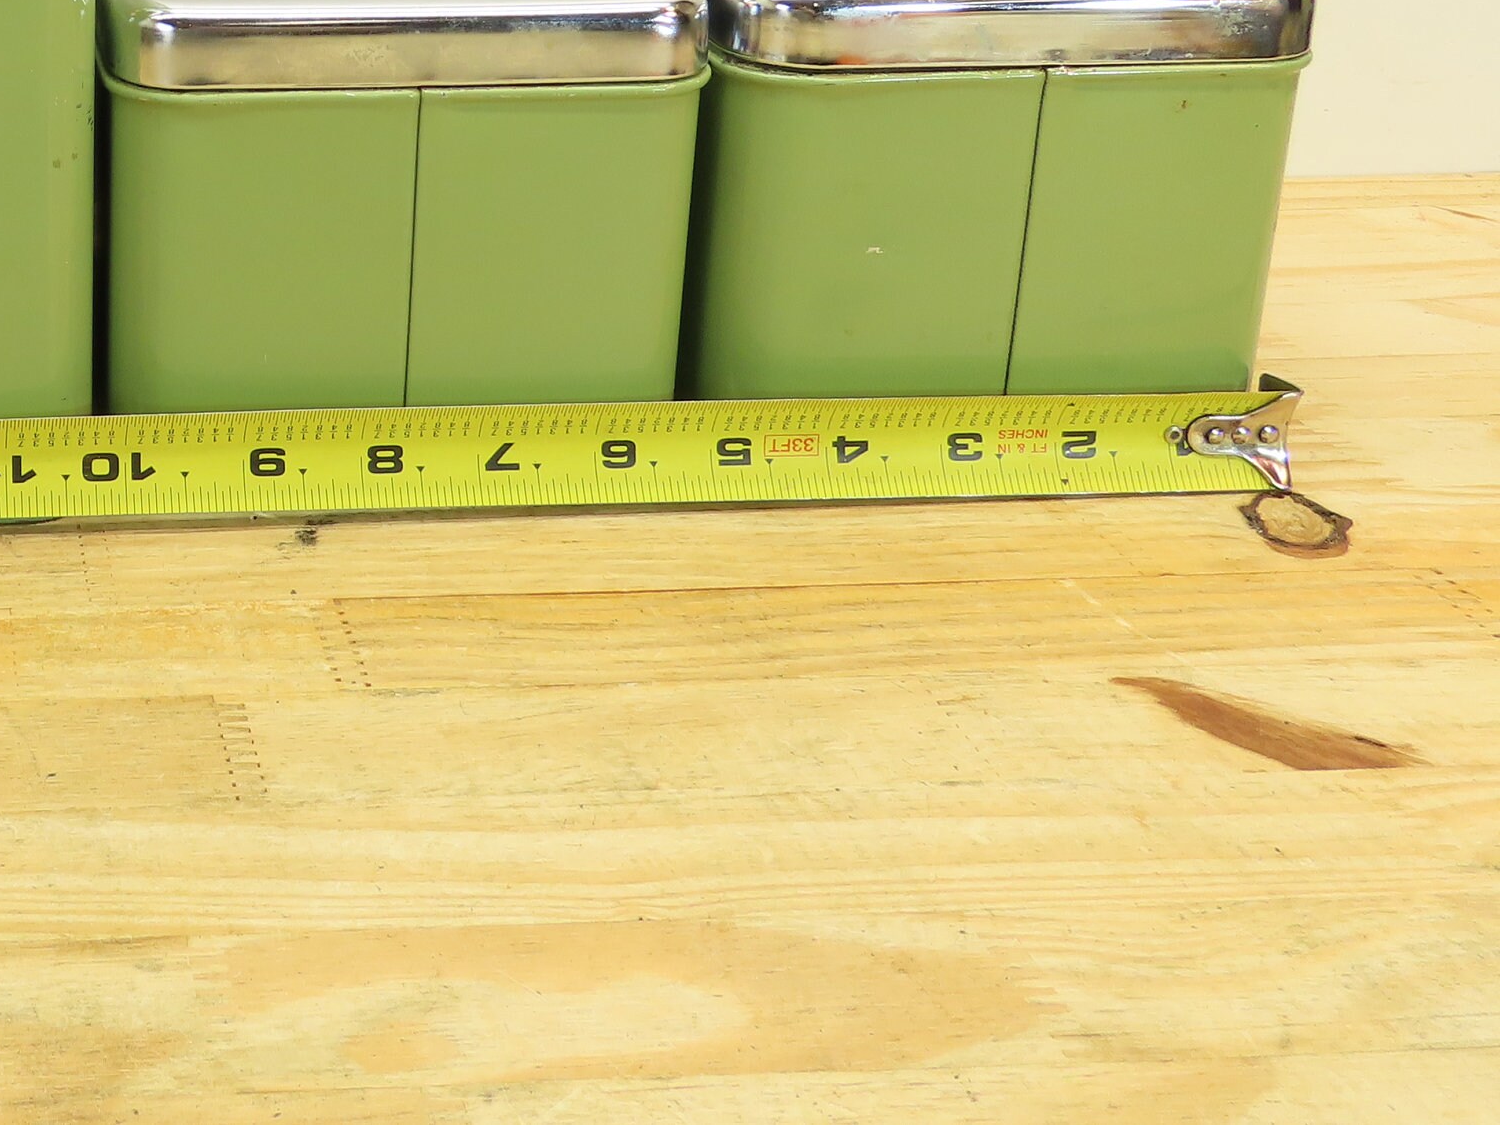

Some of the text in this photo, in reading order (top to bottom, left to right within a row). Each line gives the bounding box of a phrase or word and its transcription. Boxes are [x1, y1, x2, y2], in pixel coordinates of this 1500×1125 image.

[769, 438, 814, 453] 33FT
[947, 432, 983, 461] 3
[998, 428, 1049, 439] INCHES
[1061, 430, 1097, 459] 2
[249, 447, 286, 477] 9
[367, 444, 404, 474] 8
[485, 442, 520, 472] 7
[601, 439, 637, 469] 6
[716, 437, 752, 466] 5
[832, 435, 869, 464] 4
[997, 443, 1048, 454] FT & IN
[81, 452, 156, 482] 10
